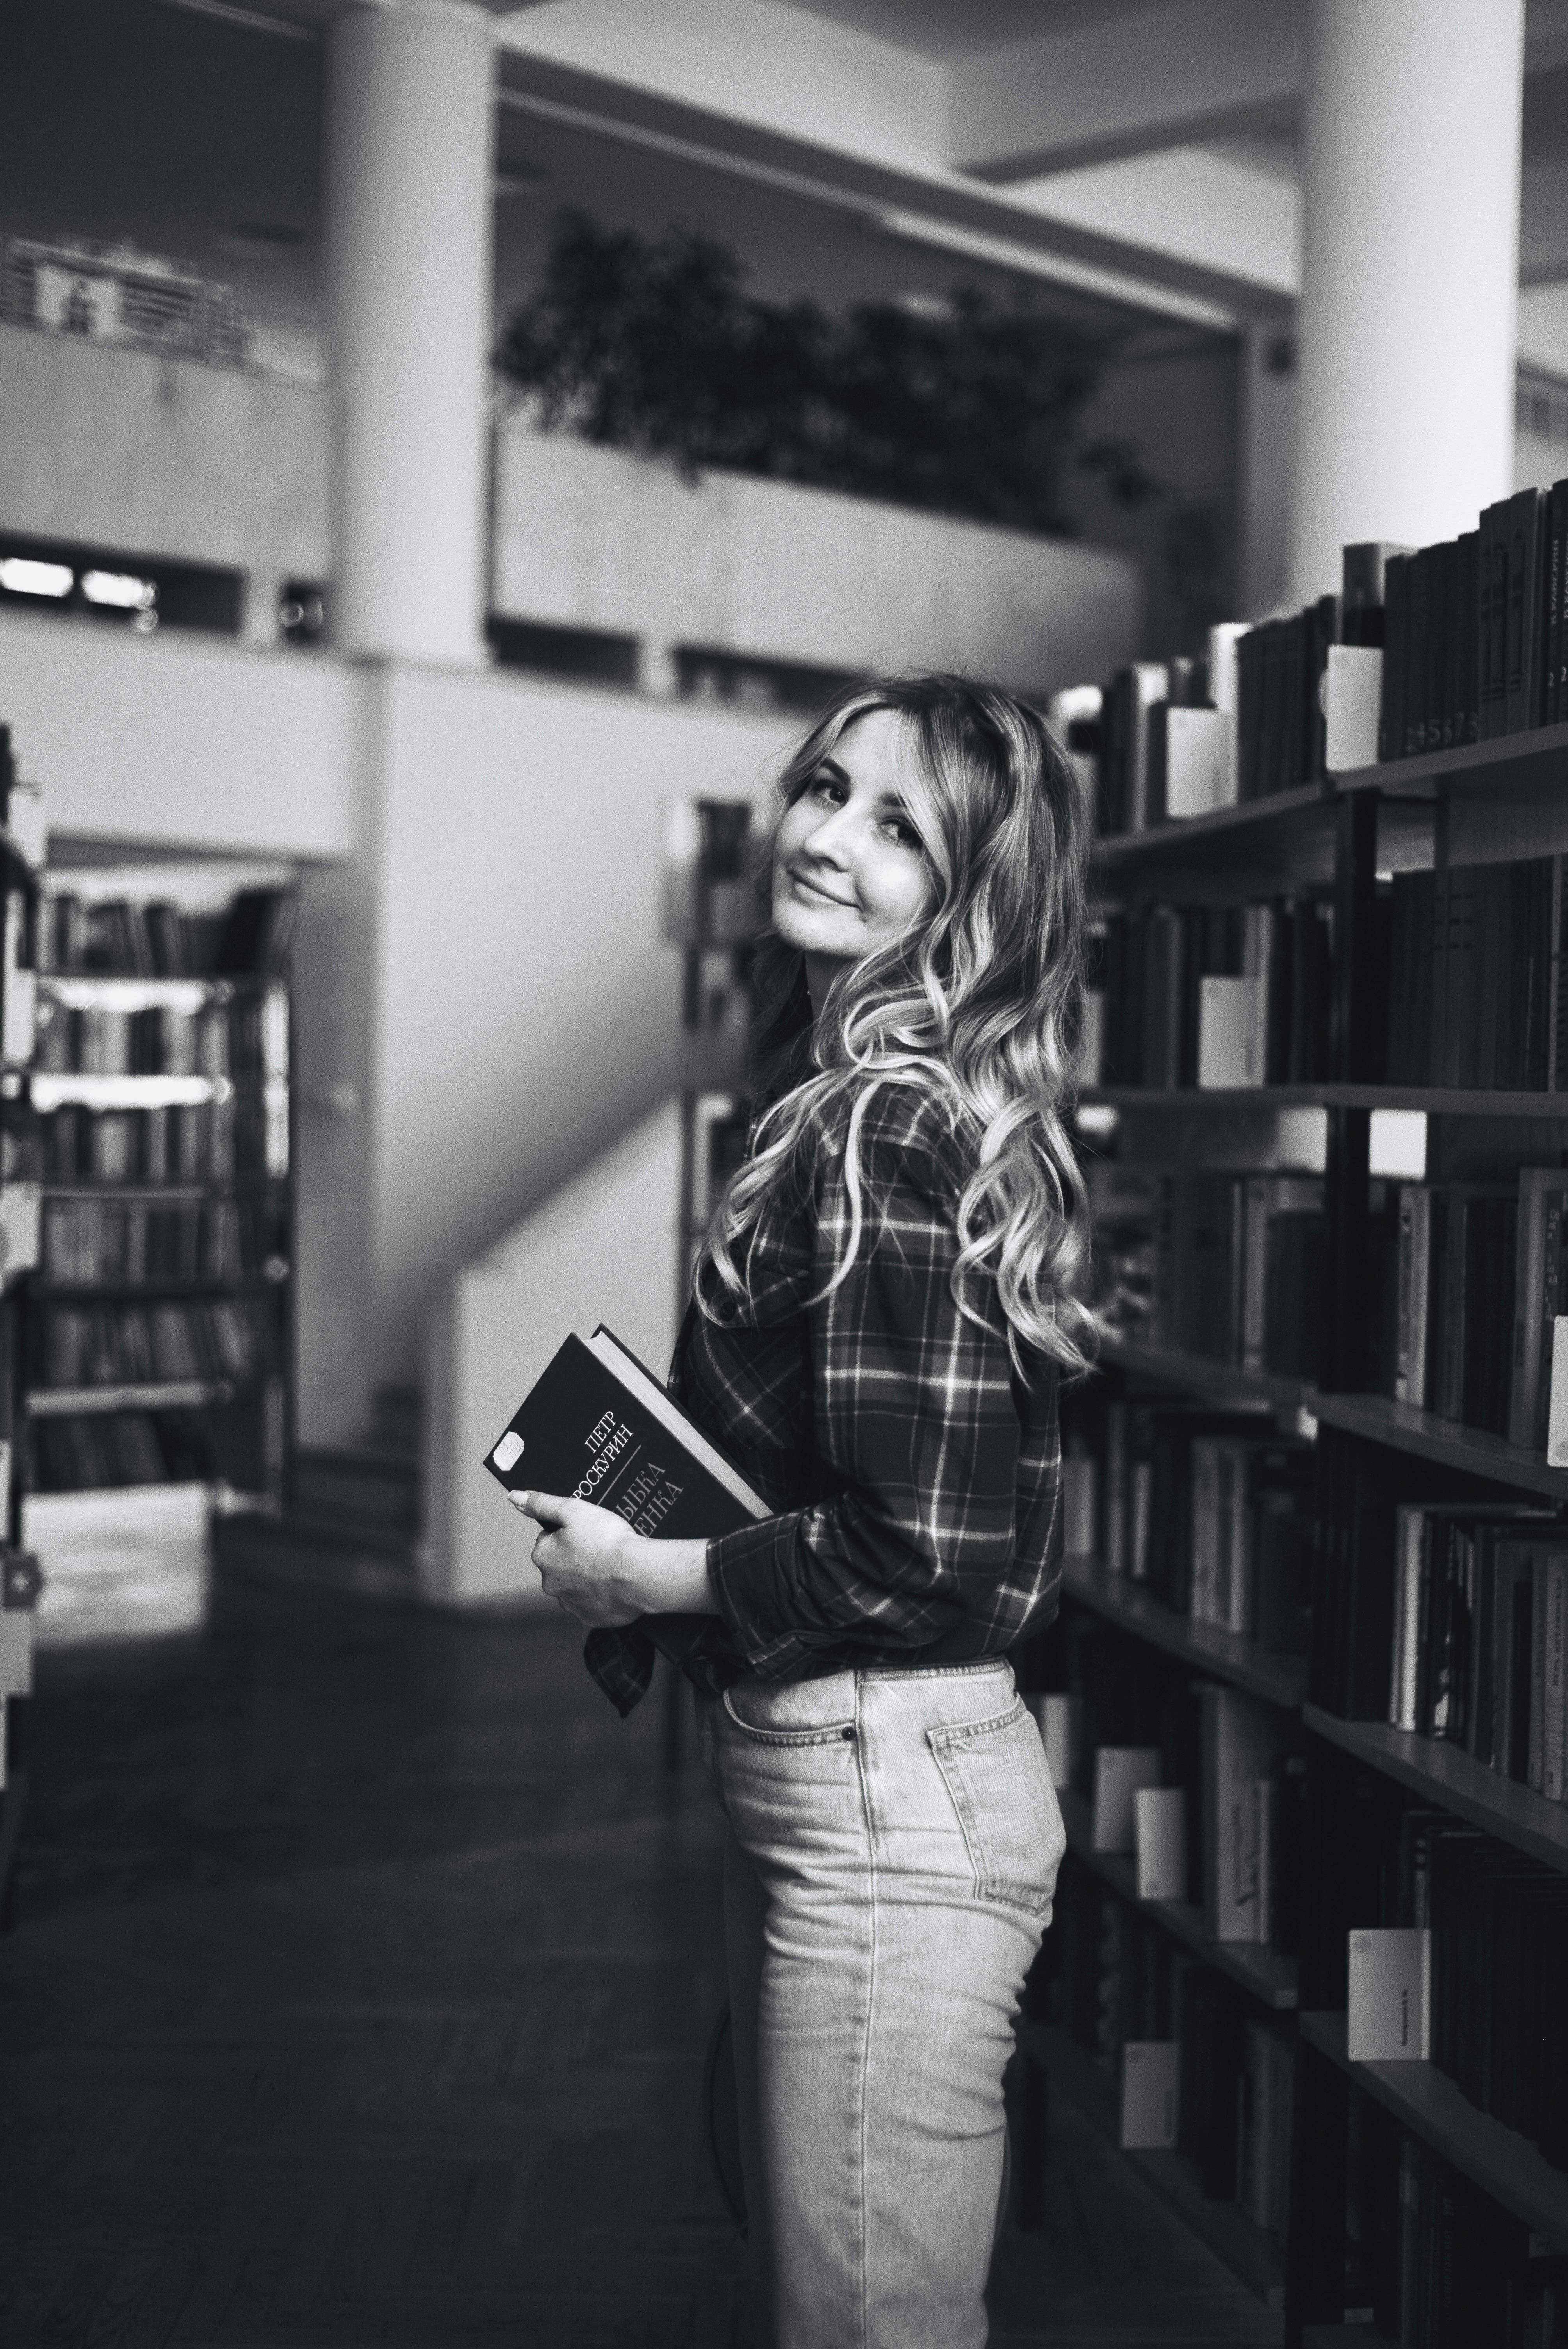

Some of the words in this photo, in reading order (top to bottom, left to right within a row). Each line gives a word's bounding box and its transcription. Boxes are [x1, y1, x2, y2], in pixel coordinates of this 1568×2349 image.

[585, 1411, 616, 1453] ПЕТР
[570, 1424, 633, 1499] РОСКУРИН
[613, 1463, 666, 1522] ЫБКА
[633, 1481, 684, 1538] ЕНКА
